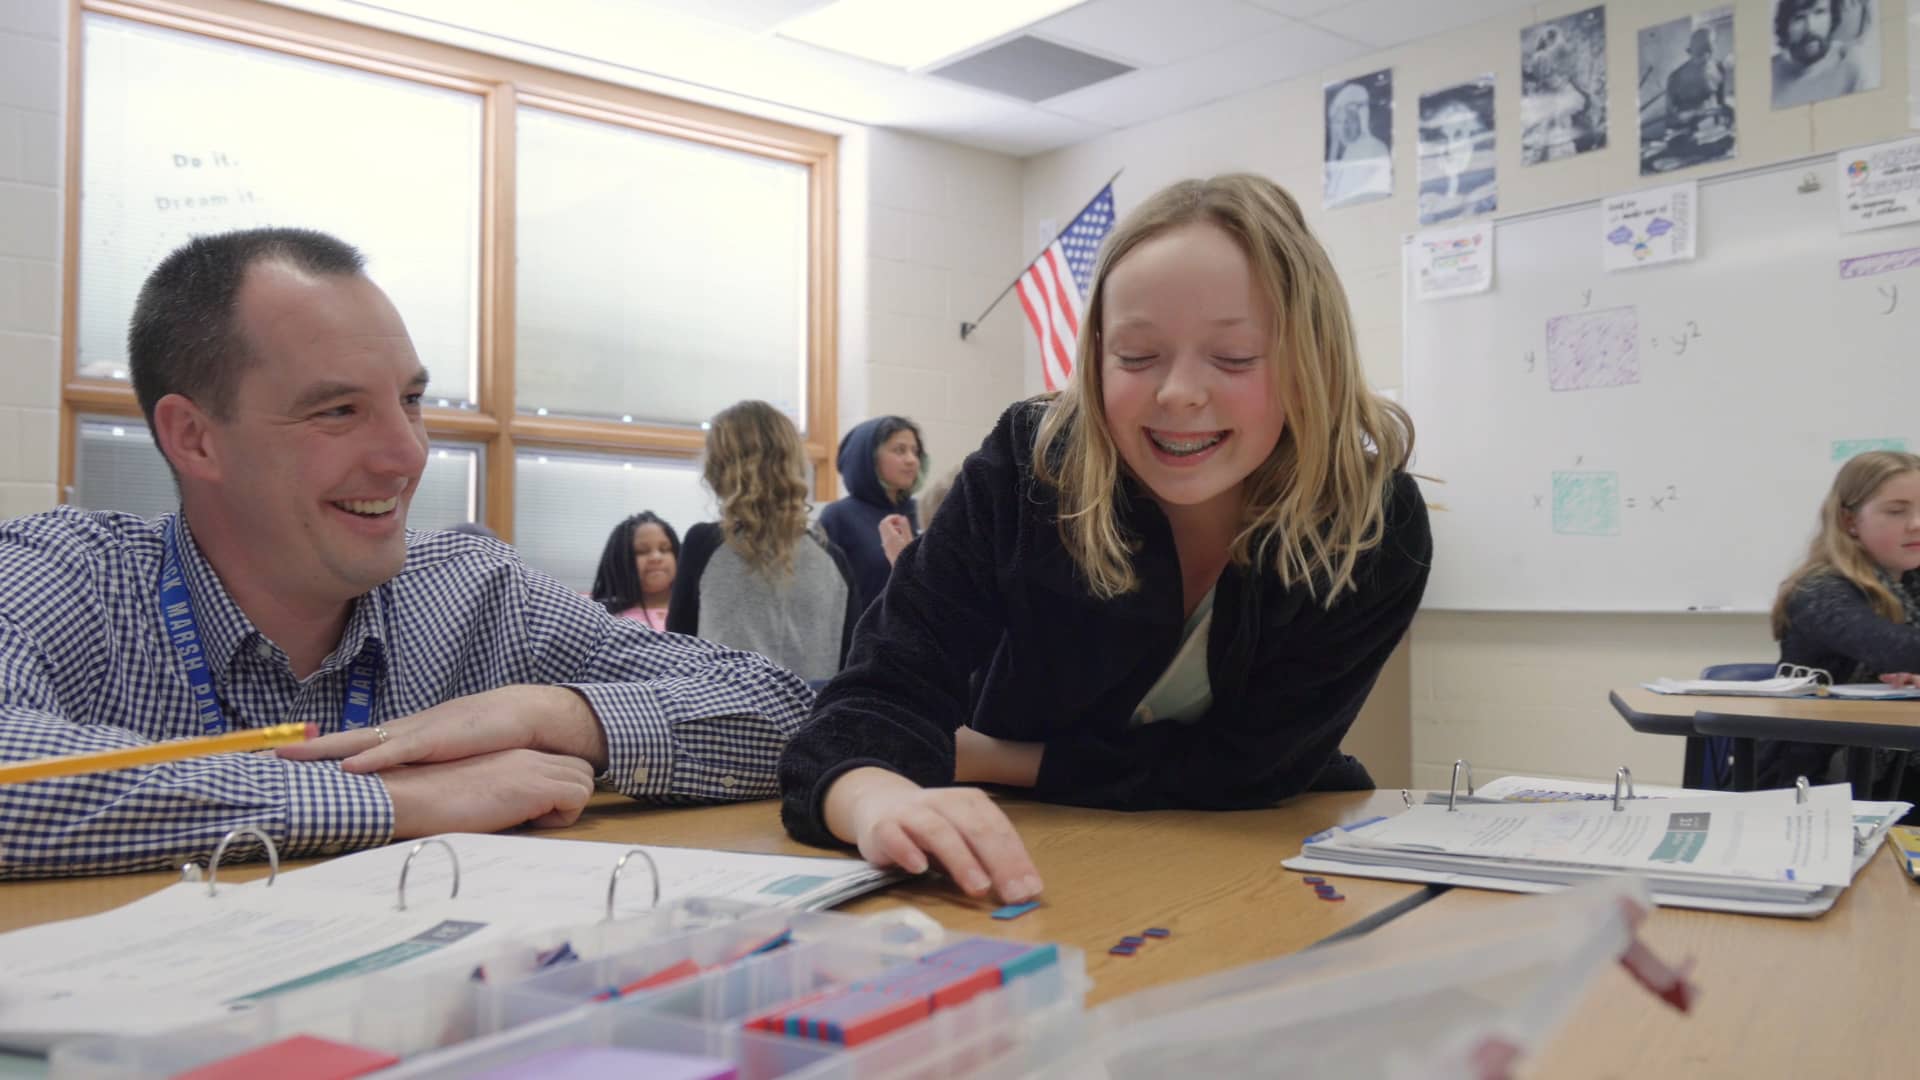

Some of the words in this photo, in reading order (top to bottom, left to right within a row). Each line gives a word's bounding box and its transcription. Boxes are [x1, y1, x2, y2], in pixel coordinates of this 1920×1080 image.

[173, 153, 202, 168] Do
[155, 195, 229, 211] Dream
[1875, 283, 1899, 317] y
[166, 600, 205, 671] MARSH
